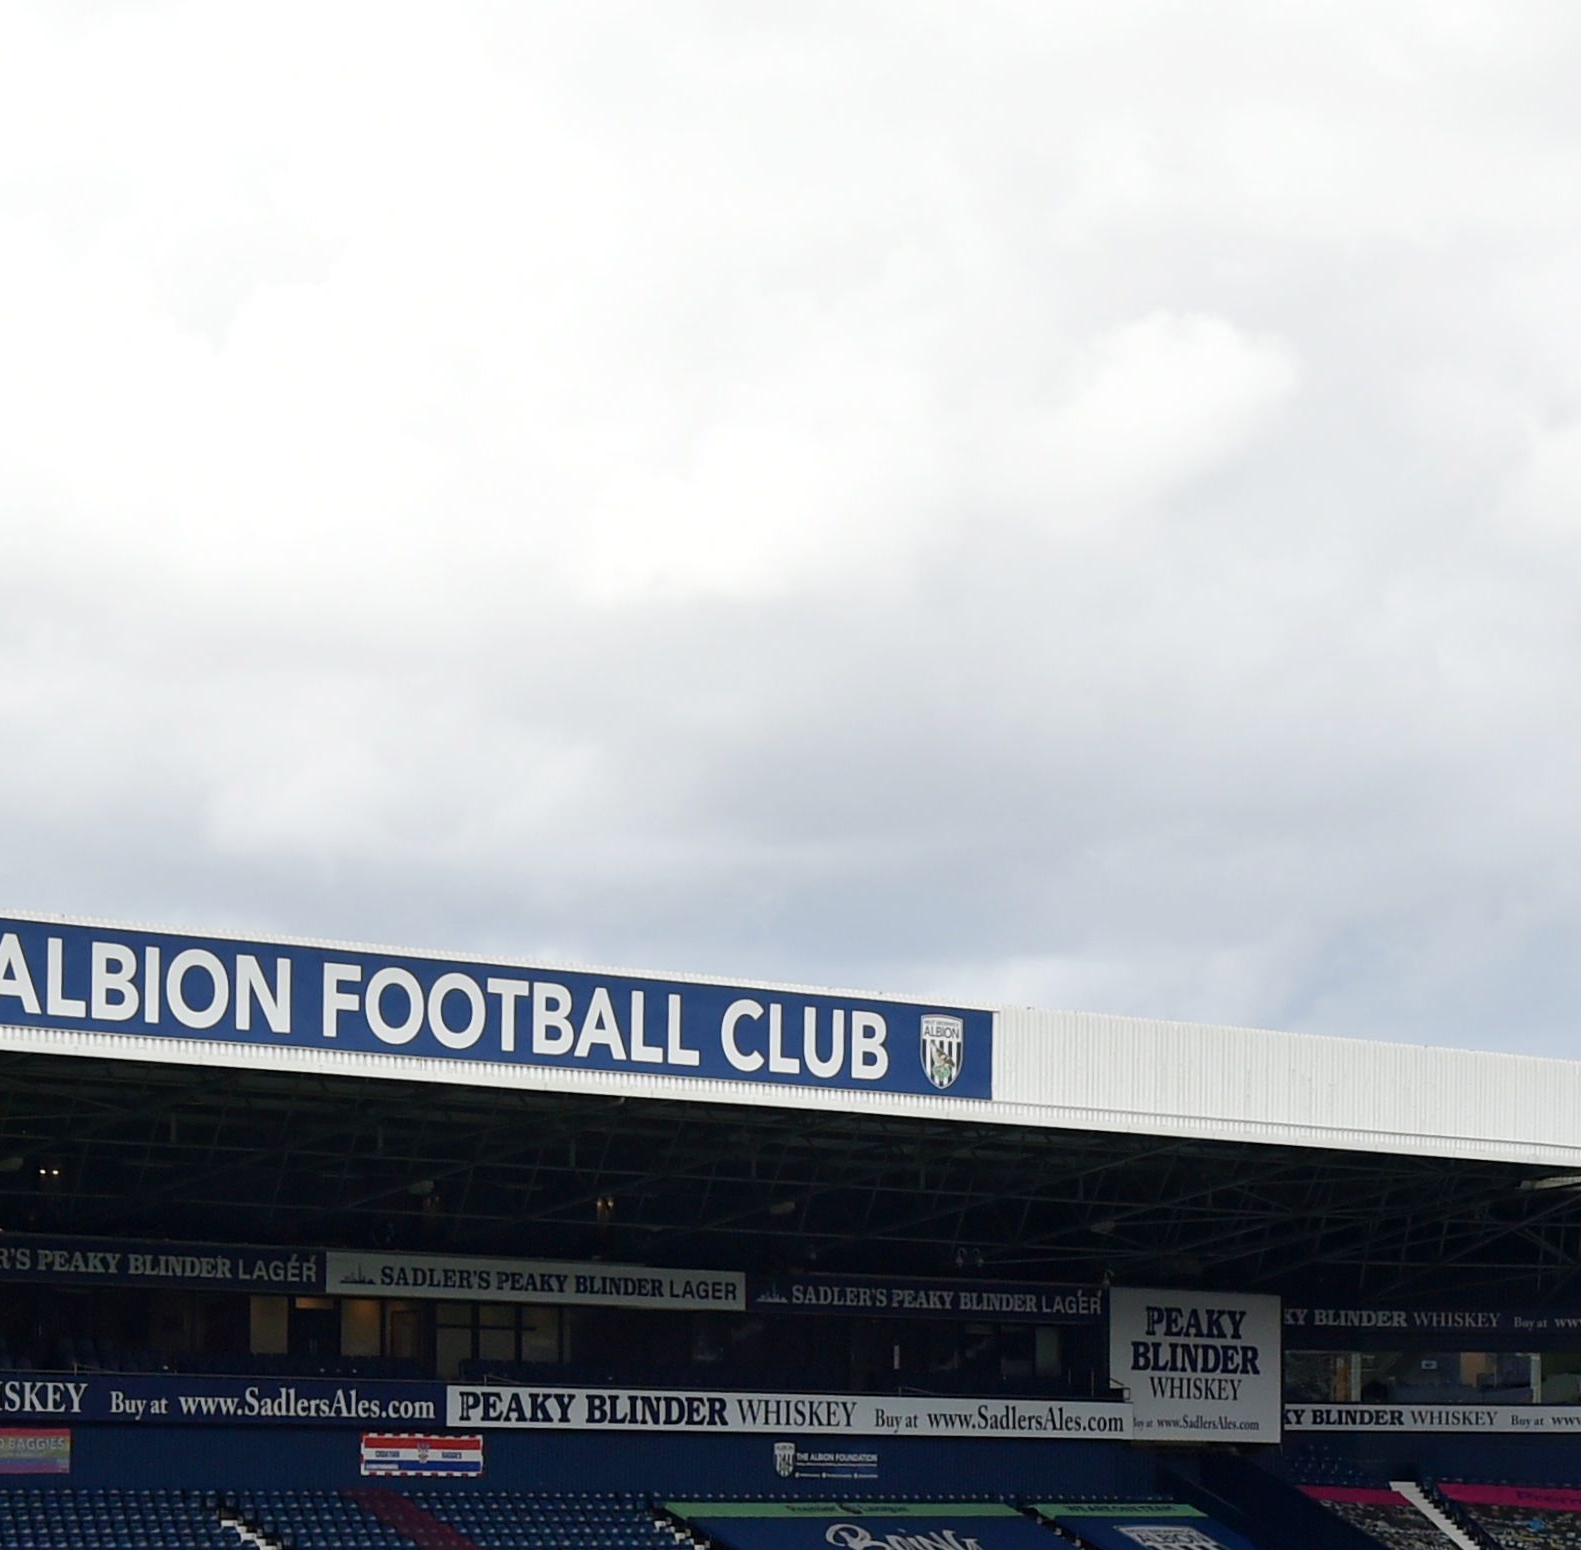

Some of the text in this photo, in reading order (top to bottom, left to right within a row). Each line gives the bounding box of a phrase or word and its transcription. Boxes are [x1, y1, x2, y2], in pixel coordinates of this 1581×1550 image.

[320, 960, 700, 1068] FOOTBALL
[720, 997, 890, 1081] CLUB
[923, 1025, 960, 1040] ALBION
[36, 1250, 121, 1276] PEAKY
[126, 1252, 233, 1280] BLINDER
[380, 1265, 737, 1301] SADLER'S PEAKY BLINDER LAGER
[790, 1284, 1102, 1316] SADLER'S PEAKY BLINDER LAGER
[1145, 1306, 1247, 1340] PEAKY
[1314, 1308, 1408, 1328] BLINDER
[1412, 1311, 1501, 1329] WHISKEY
[1513, 1316, 1536, 1330] Buy
[1537, 1319, 1549, 1329] at
[1131, 1341, 1261, 1375] BLINDER
[109, 1391, 147, 1422] Buy
[149, 1396, 169, 1415] at
[178, 1385, 437, 1421] www.SadlersAles.com
[1149, 1376, 1243, 1401] WHISKEY
[458, 1391, 1125, 1434] PEAKY BLINDER WHISKEY Buy at www.SadlersAles.com
[1156, 1414, 1260, 1431] www.SadlersAles.com
[1311, 1409, 1405, 1427] BLINDER
[1410, 1411, 1498, 1427] WHISKEY
[1510, 1415, 1532, 1429] Buy
[1533, 1418, 1545, 1427] at
[8, 1437, 65, 1450] BAGGIES
